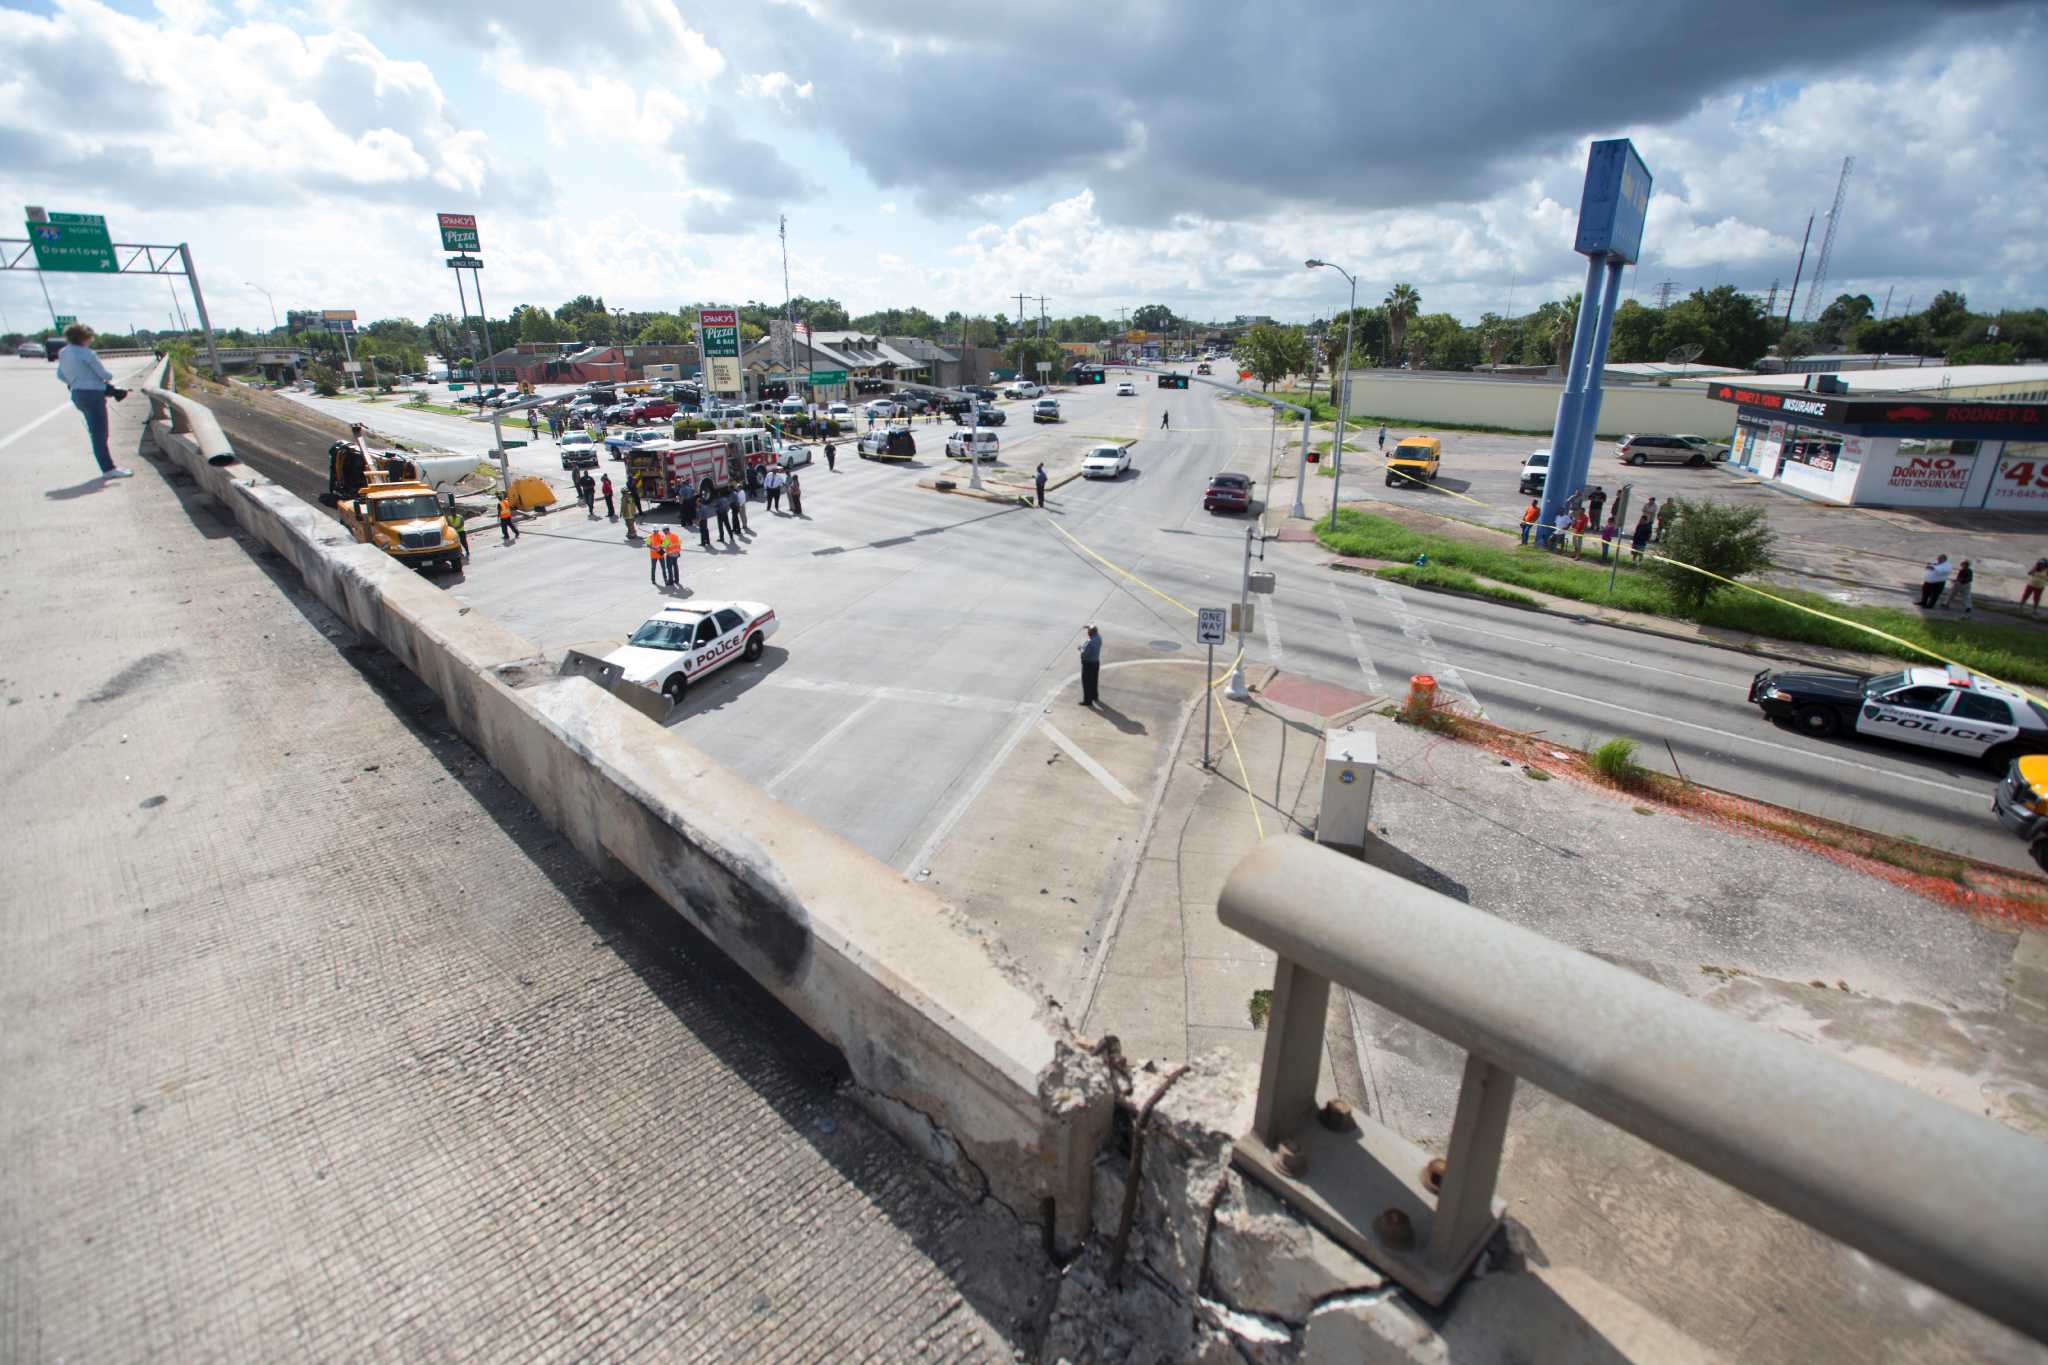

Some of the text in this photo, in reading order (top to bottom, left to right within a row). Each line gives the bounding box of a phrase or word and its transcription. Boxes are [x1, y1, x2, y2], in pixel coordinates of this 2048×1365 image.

[445, 231, 476, 243] Pizza
[41, 245, 107, 256] Downtown
[703, 313, 735, 323] SPANKY'S
[705, 328, 734, 339] Pizza
[1782, 398, 1828, 416] INSURANCE
[1946, 406, 2017, 423] RODNEY
[1910, 457, 1957, 469] NO
[1892, 465, 1969, 481] DOWN PAYMT
[1888, 478, 1968, 490] AUTO INSURANCE
[1202, 611, 1221, 622] ONE
[1201, 621, 1221, 631] WAY
[696, 634, 741, 667] POLICE
[1874, 714, 1999, 744] POLICE
